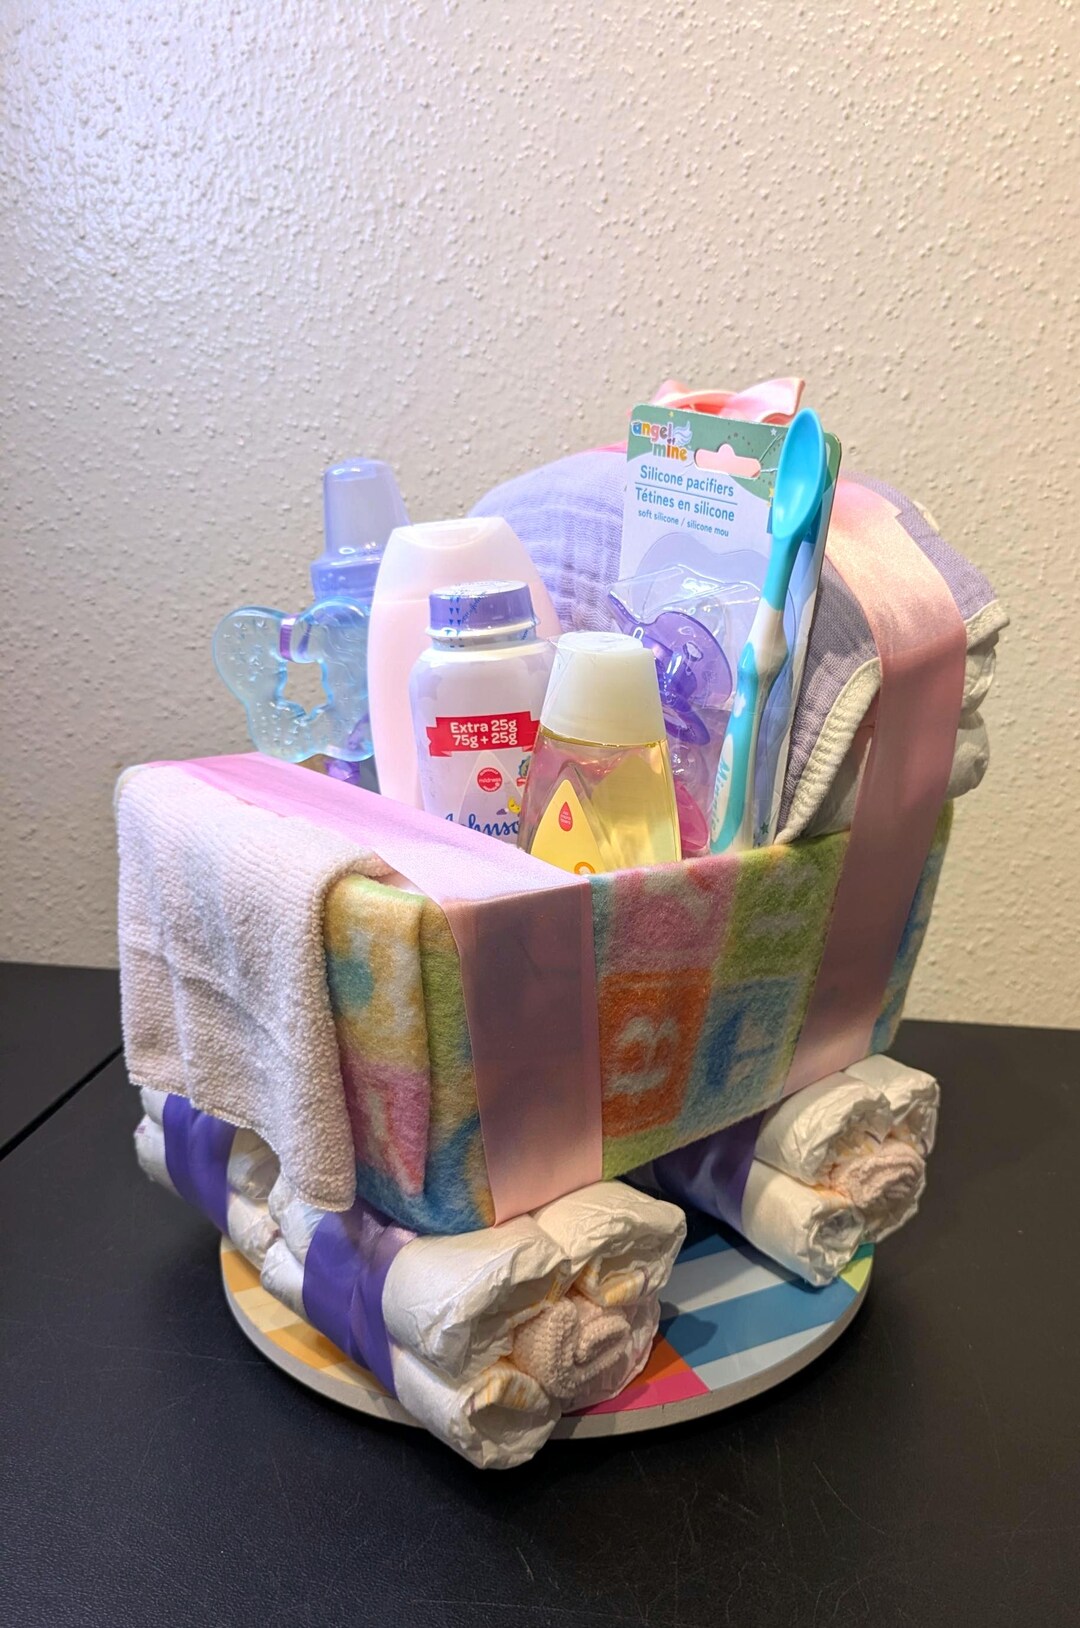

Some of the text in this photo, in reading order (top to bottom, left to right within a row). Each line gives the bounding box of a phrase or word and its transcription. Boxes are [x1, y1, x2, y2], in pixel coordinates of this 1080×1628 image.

[631, 421, 672, 443] angel
[652, 444, 688, 462] mine
[640, 465, 734, 497] Silicone pacifiers
[635, 487, 735, 522] Tétines en silicone
[638, 509, 652, 519] soft
[654, 511, 679, 525] silicone
[687, 520, 713, 533] silicone
[714, 527, 729, 537] mou
[450, 719, 518, 734] Extra 25g
[452, 732, 518, 749] 75g + 25g
